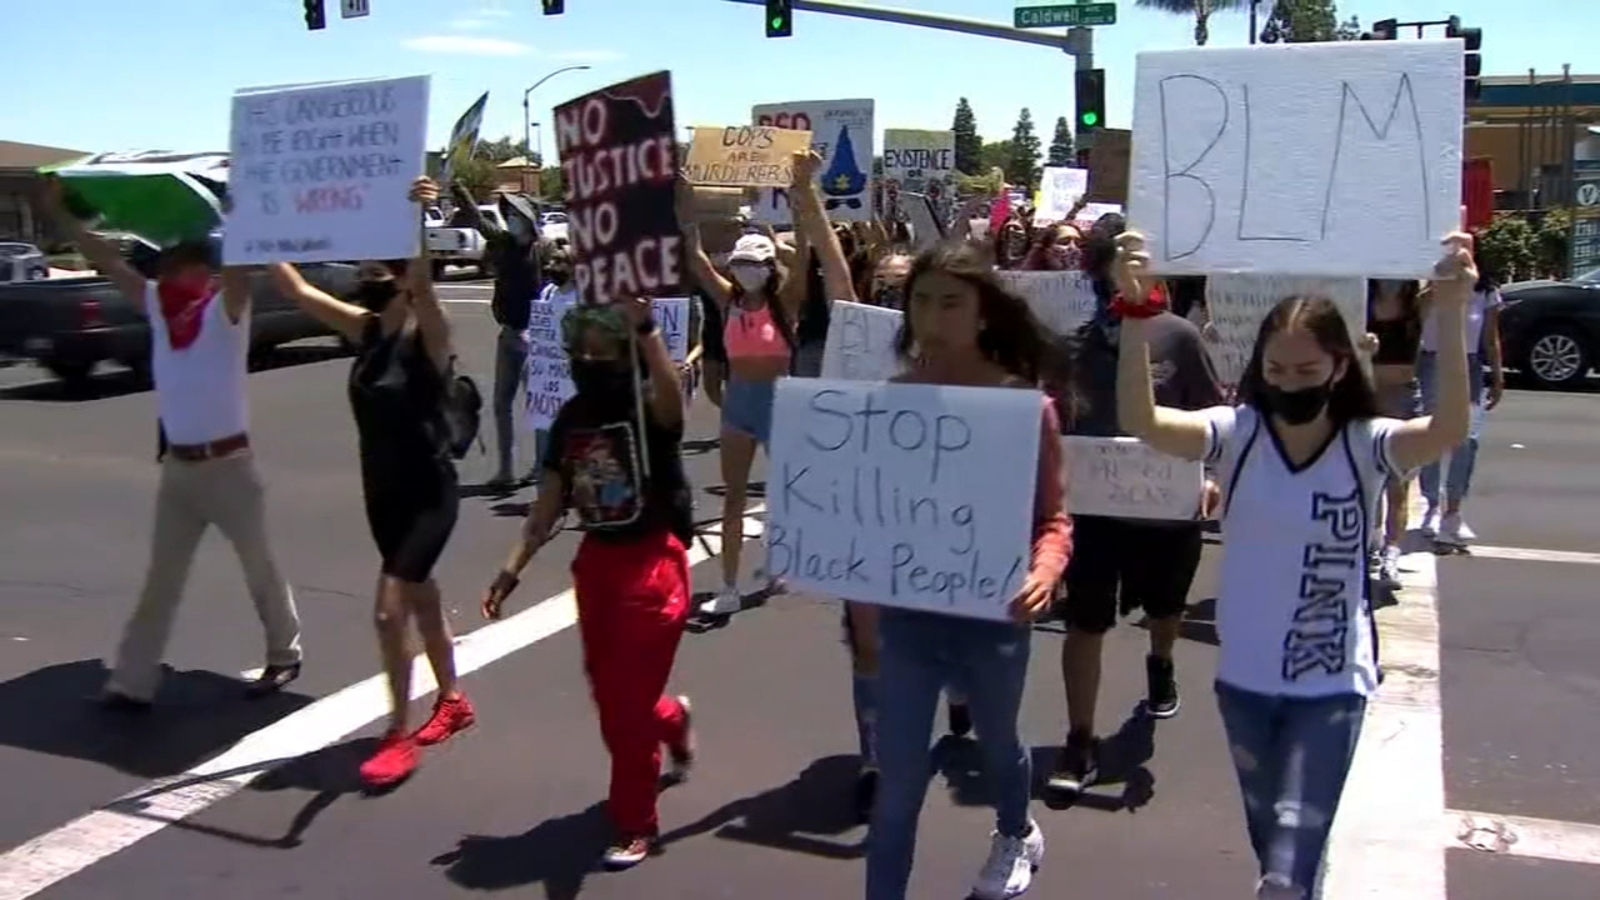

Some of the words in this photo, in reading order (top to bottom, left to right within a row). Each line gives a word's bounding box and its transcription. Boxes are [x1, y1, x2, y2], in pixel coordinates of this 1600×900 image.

[1020, 8, 1080, 23] Caldwell
[347, 121, 400, 149] WHEN
[557, 98, 608, 147] NO
[722, 126, 775, 149] COPS
[563, 135, 675, 202] JUSTICE
[728, 150, 756, 163] ARE
[884, 149, 952, 170] EXISTENCE
[1159, 71, 1431, 262] BLM
[568, 202, 619, 251] NO
[574, 236, 681, 306] PEACE
[526, 391, 562, 418] RACIST
[806, 390, 972, 484] Stop
[782, 462, 975, 556] Killing
[767, 525, 870, 581] Black
[1282, 490, 1362, 682] PINK
